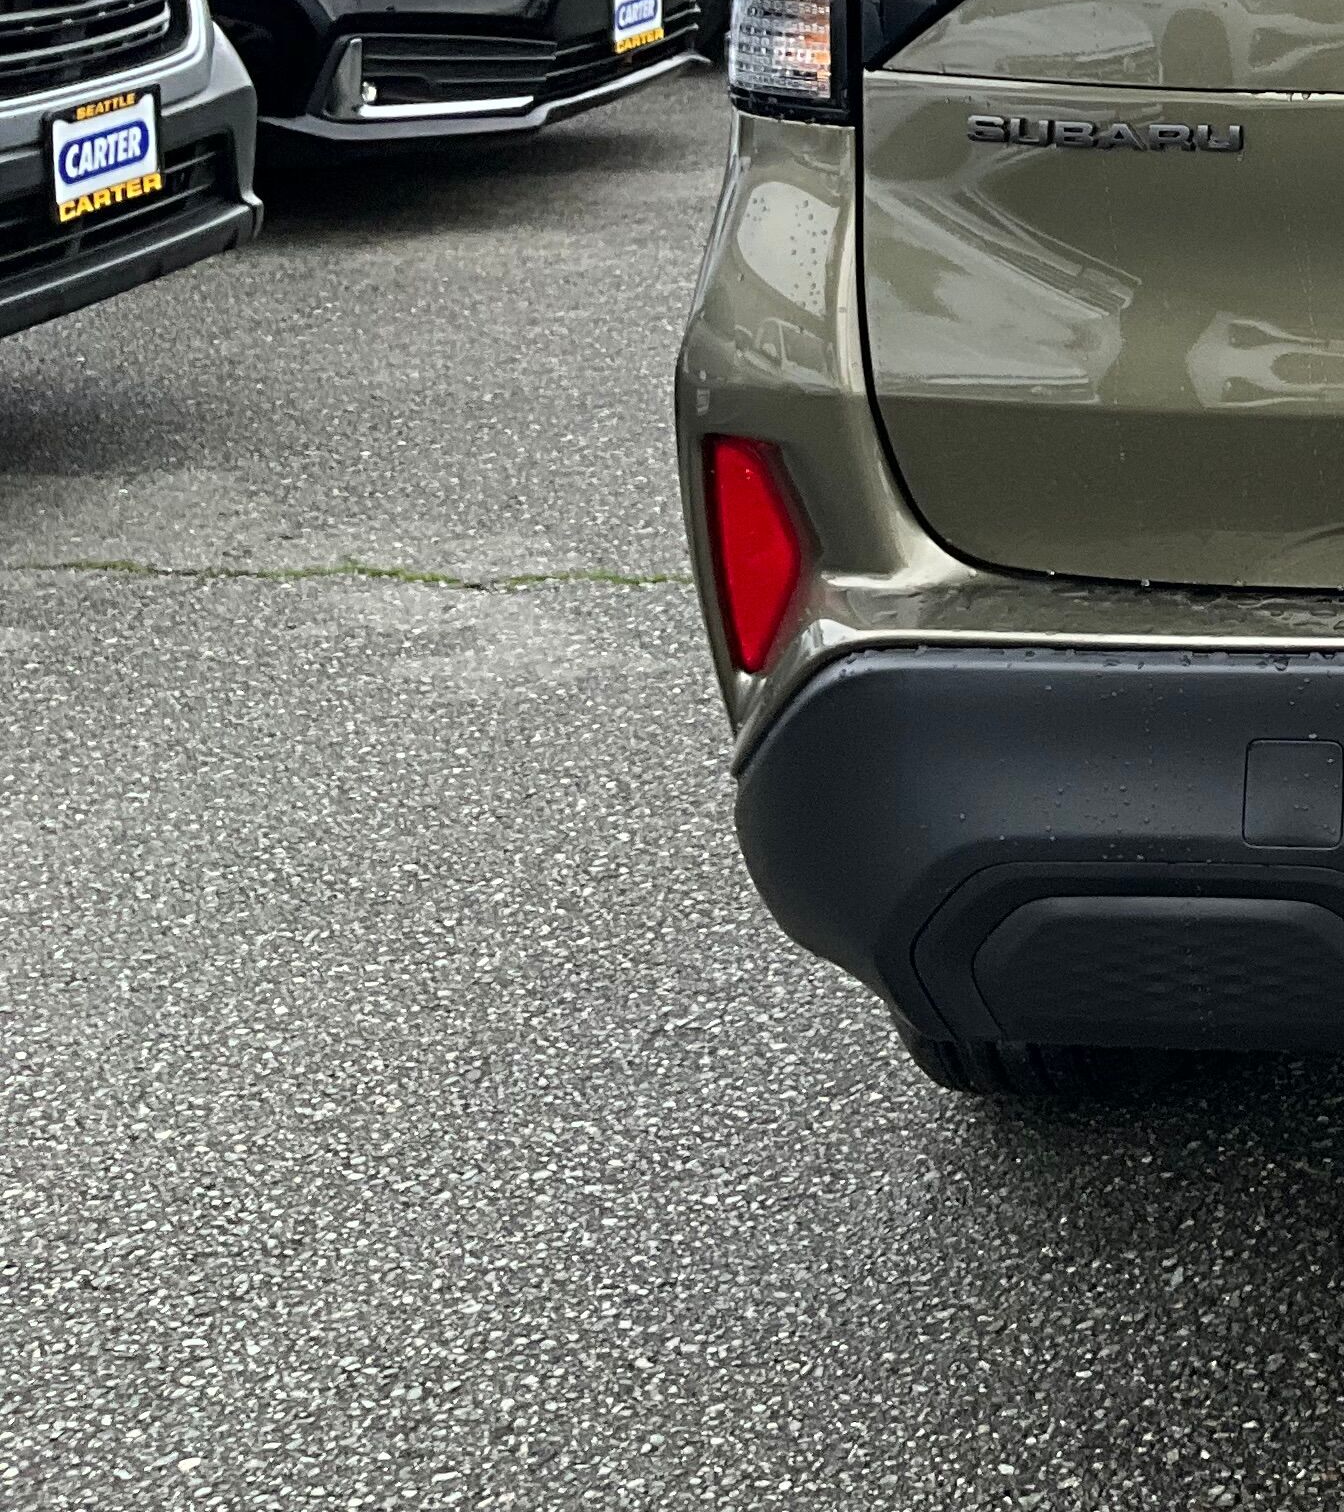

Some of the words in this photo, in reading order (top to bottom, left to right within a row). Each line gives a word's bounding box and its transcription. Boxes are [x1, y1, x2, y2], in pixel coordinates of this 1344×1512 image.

[616, 28, 664, 54] CARTER
[76, 92, 137, 121] SEATTLE
[64, 125, 142, 180] CARTER
[967, 114, 1245, 153] SUBARU
[59, 172, 162, 223] CARTER
